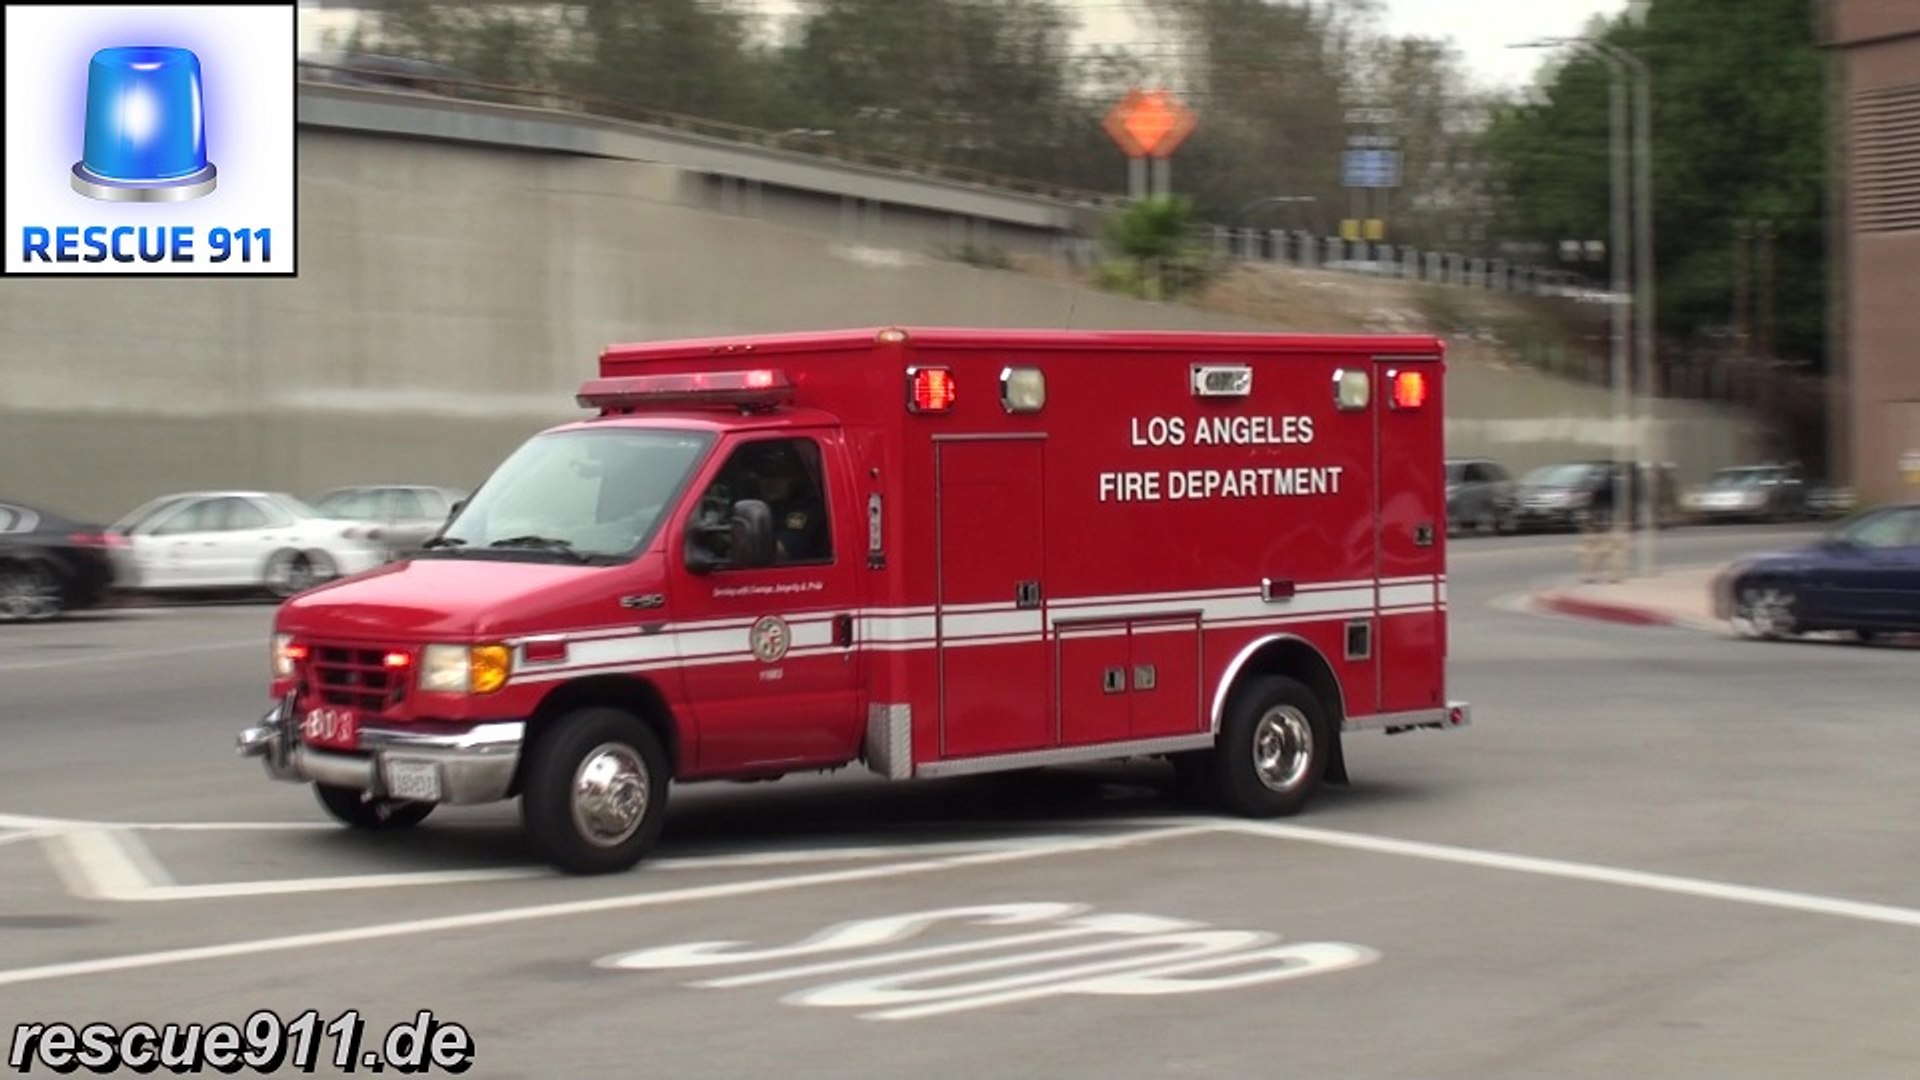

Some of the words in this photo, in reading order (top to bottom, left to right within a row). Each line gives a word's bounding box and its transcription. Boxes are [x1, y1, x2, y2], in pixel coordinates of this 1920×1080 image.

[1131, 416, 1186, 446] LOS
[1194, 416, 1314, 445] ANGELES
[1099, 471, 1161, 502] FIRE
[1168, 466, 1343, 500] DEPARTMENT
[592, 902, 1381, 1021] STOP
